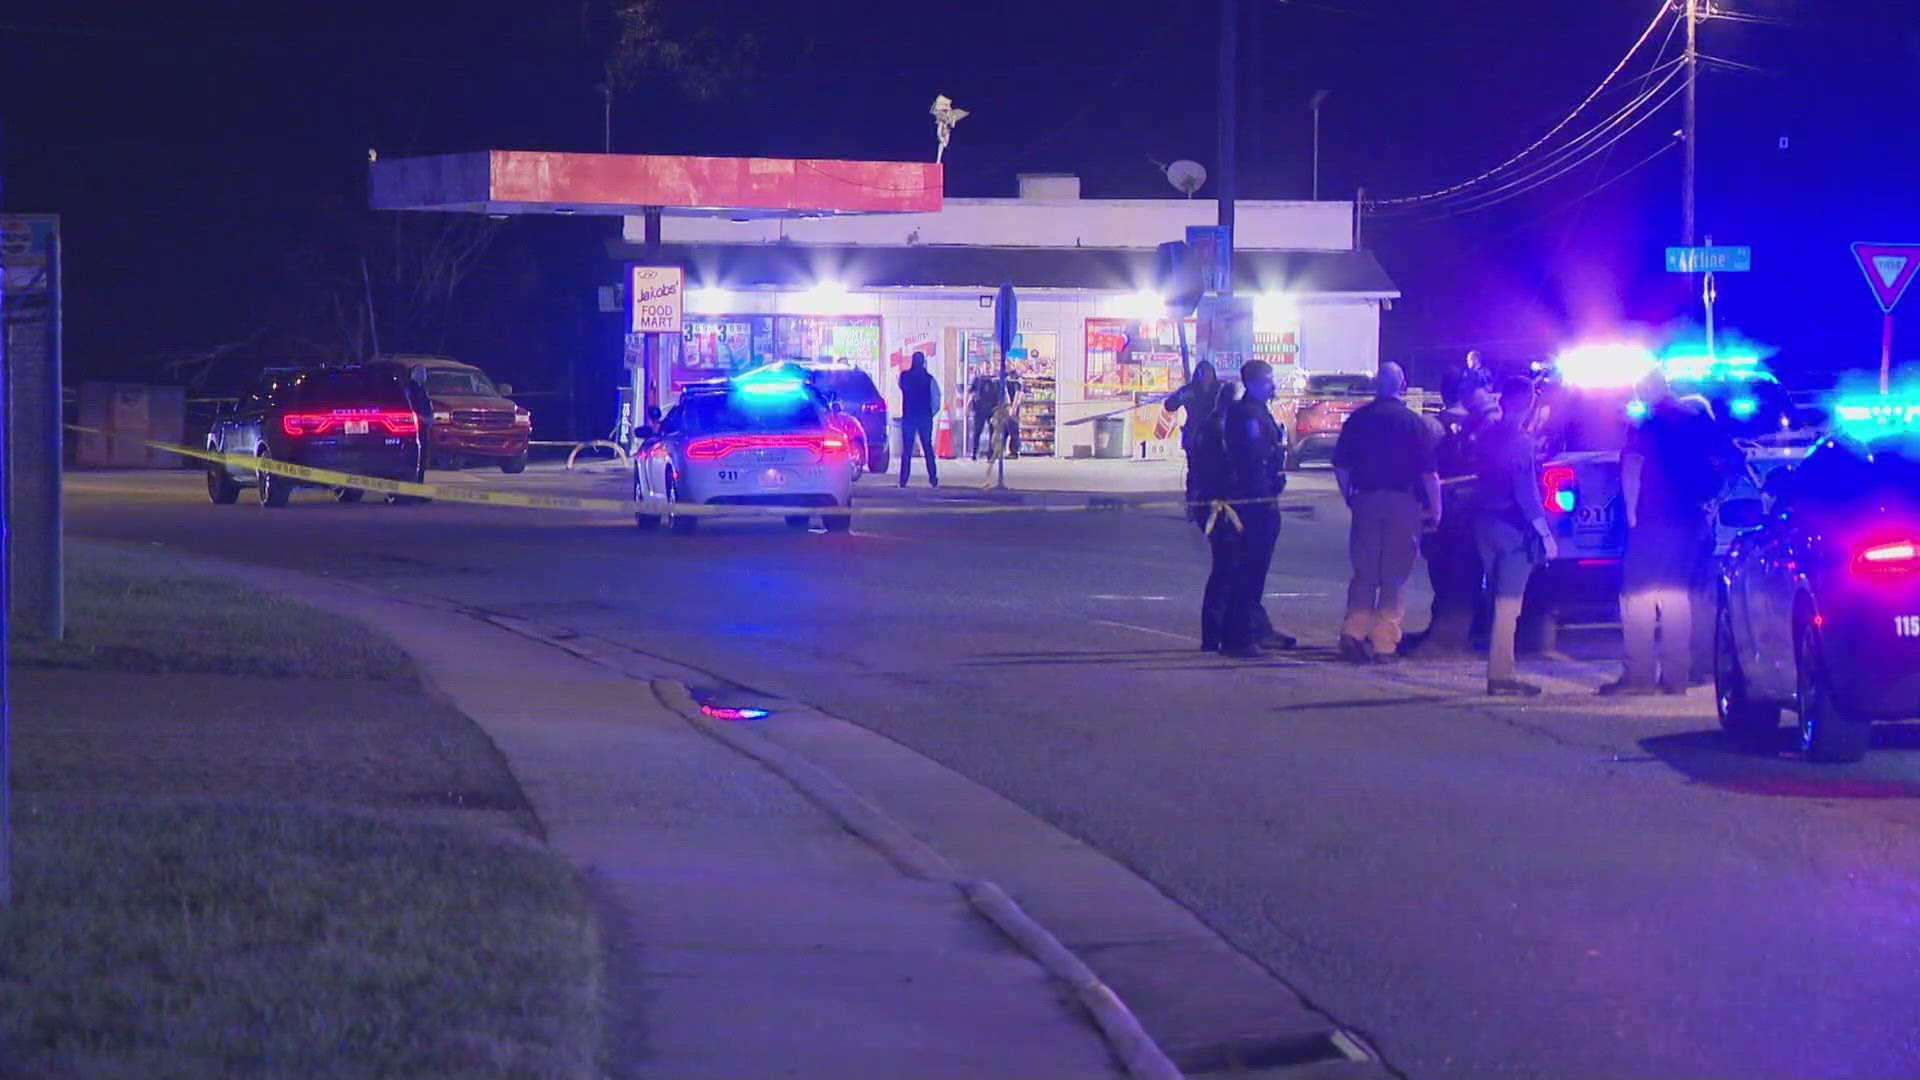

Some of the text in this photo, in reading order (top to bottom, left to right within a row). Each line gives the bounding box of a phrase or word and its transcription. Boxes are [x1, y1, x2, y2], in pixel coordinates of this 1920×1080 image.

[642, 305, 673, 316] FOOD
[641, 316, 673, 328] MART
[718, 470, 738, 481] 911
[1580, 508, 1609, 522] 911
